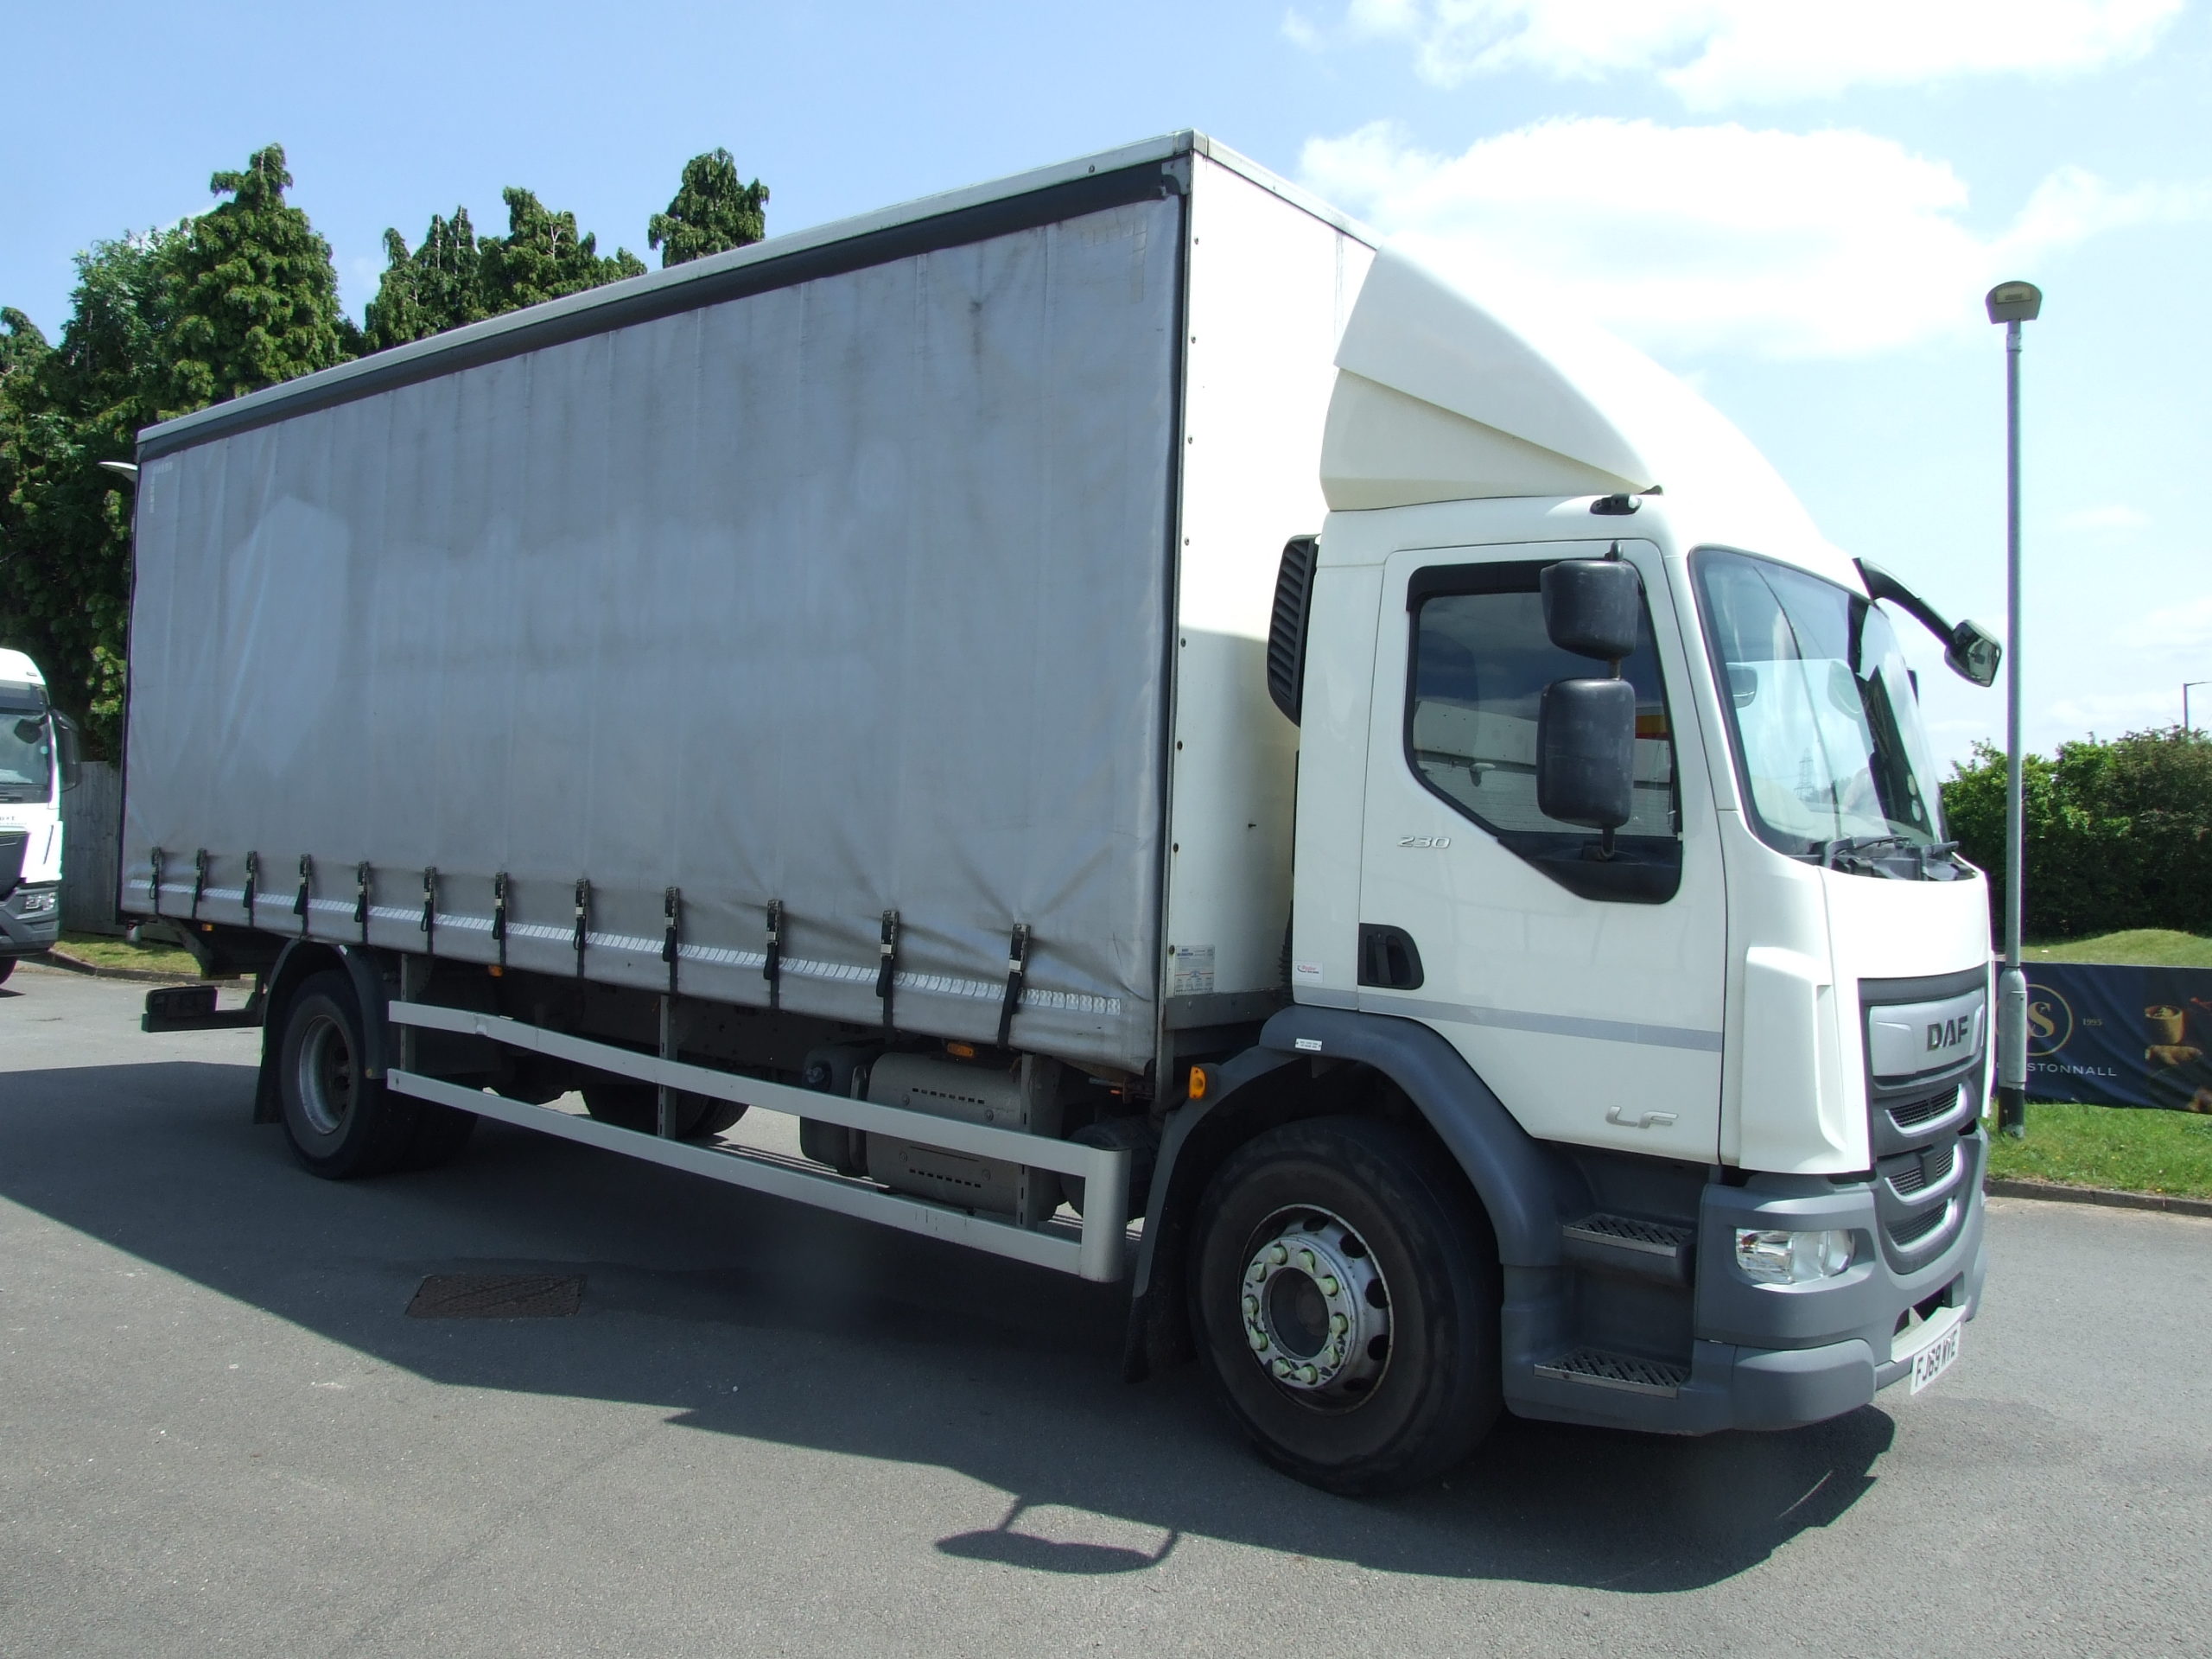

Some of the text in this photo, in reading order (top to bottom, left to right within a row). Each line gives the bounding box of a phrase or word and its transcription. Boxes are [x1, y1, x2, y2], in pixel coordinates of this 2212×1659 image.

[1396, 835, 1452, 849] 230
[1927, 1014, 1968, 1052] DAF
[2026, 1062, 2118, 1077] STONNALL
[1605, 1104, 1679, 1129] LF
